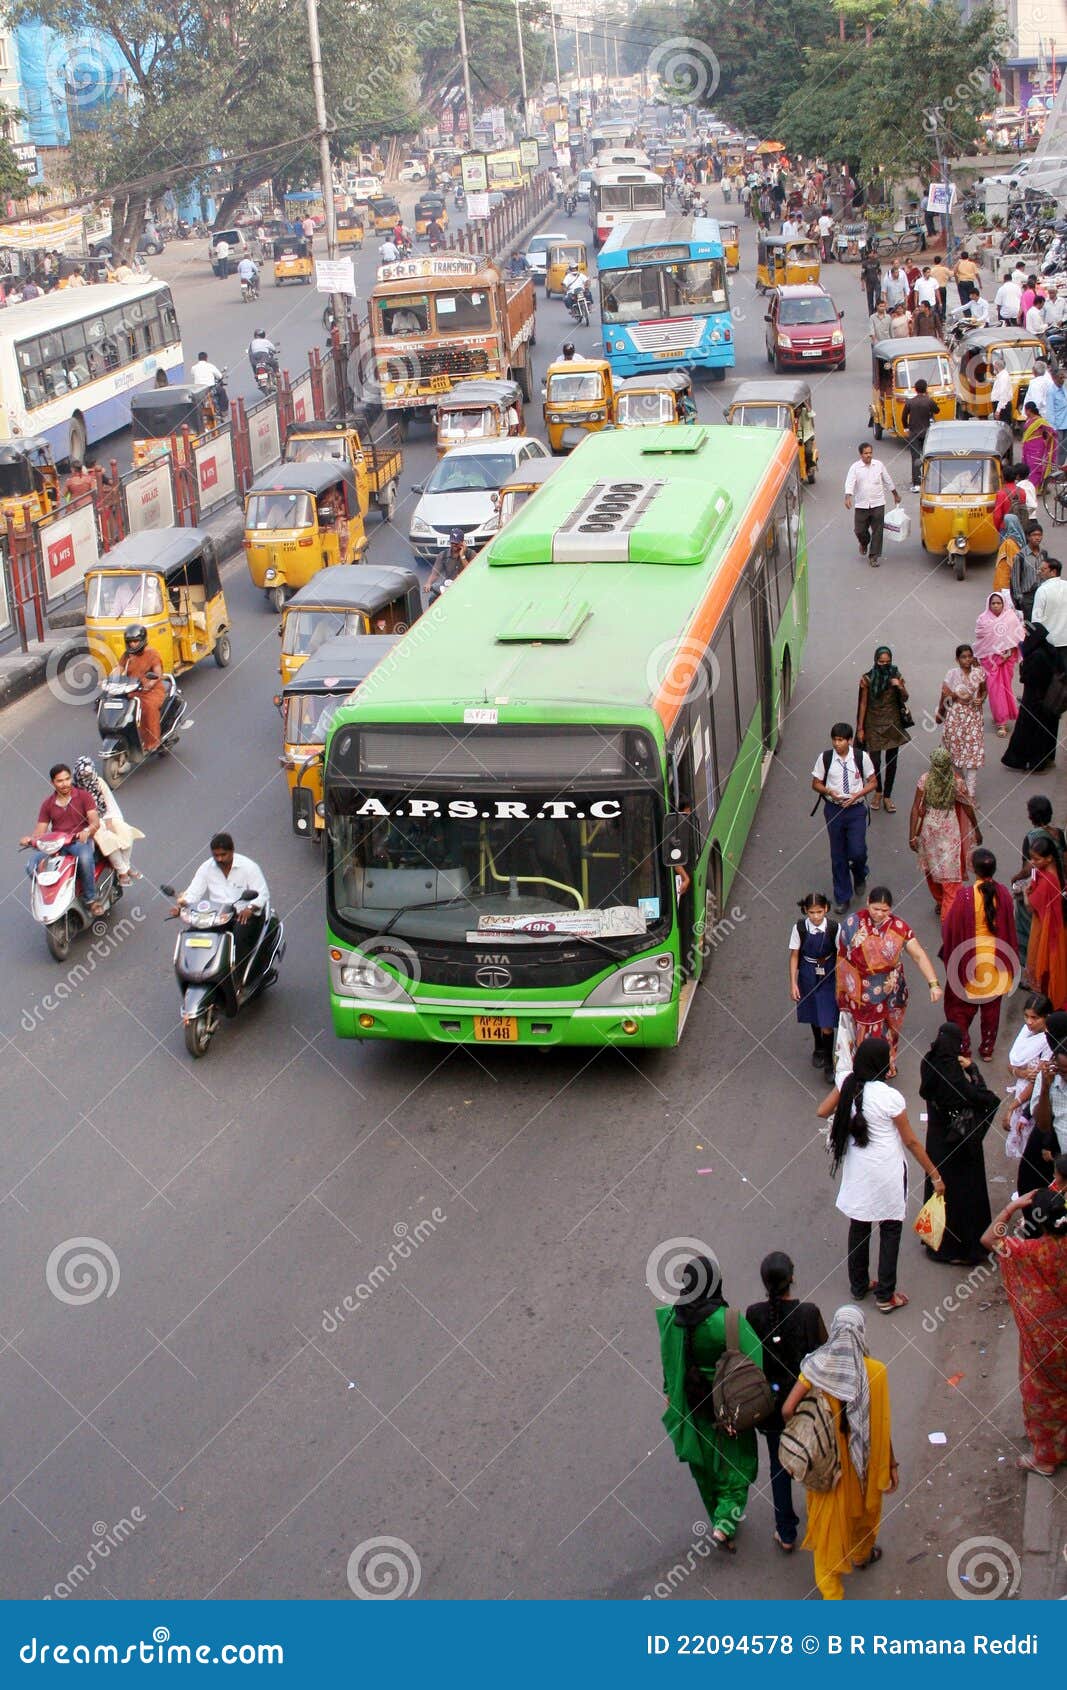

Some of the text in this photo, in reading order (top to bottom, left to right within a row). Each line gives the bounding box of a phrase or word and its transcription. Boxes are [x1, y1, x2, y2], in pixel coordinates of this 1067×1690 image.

[433, 261, 473, 274] TRANSPORT
[59, 547, 71, 561] MTS
[356, 798, 622, 819] A.P.S.R.T.C
[525, 921, 551, 932] 19K
[475, 954, 511, 965] TATA
[482, 1027, 510, 1040] 1148
